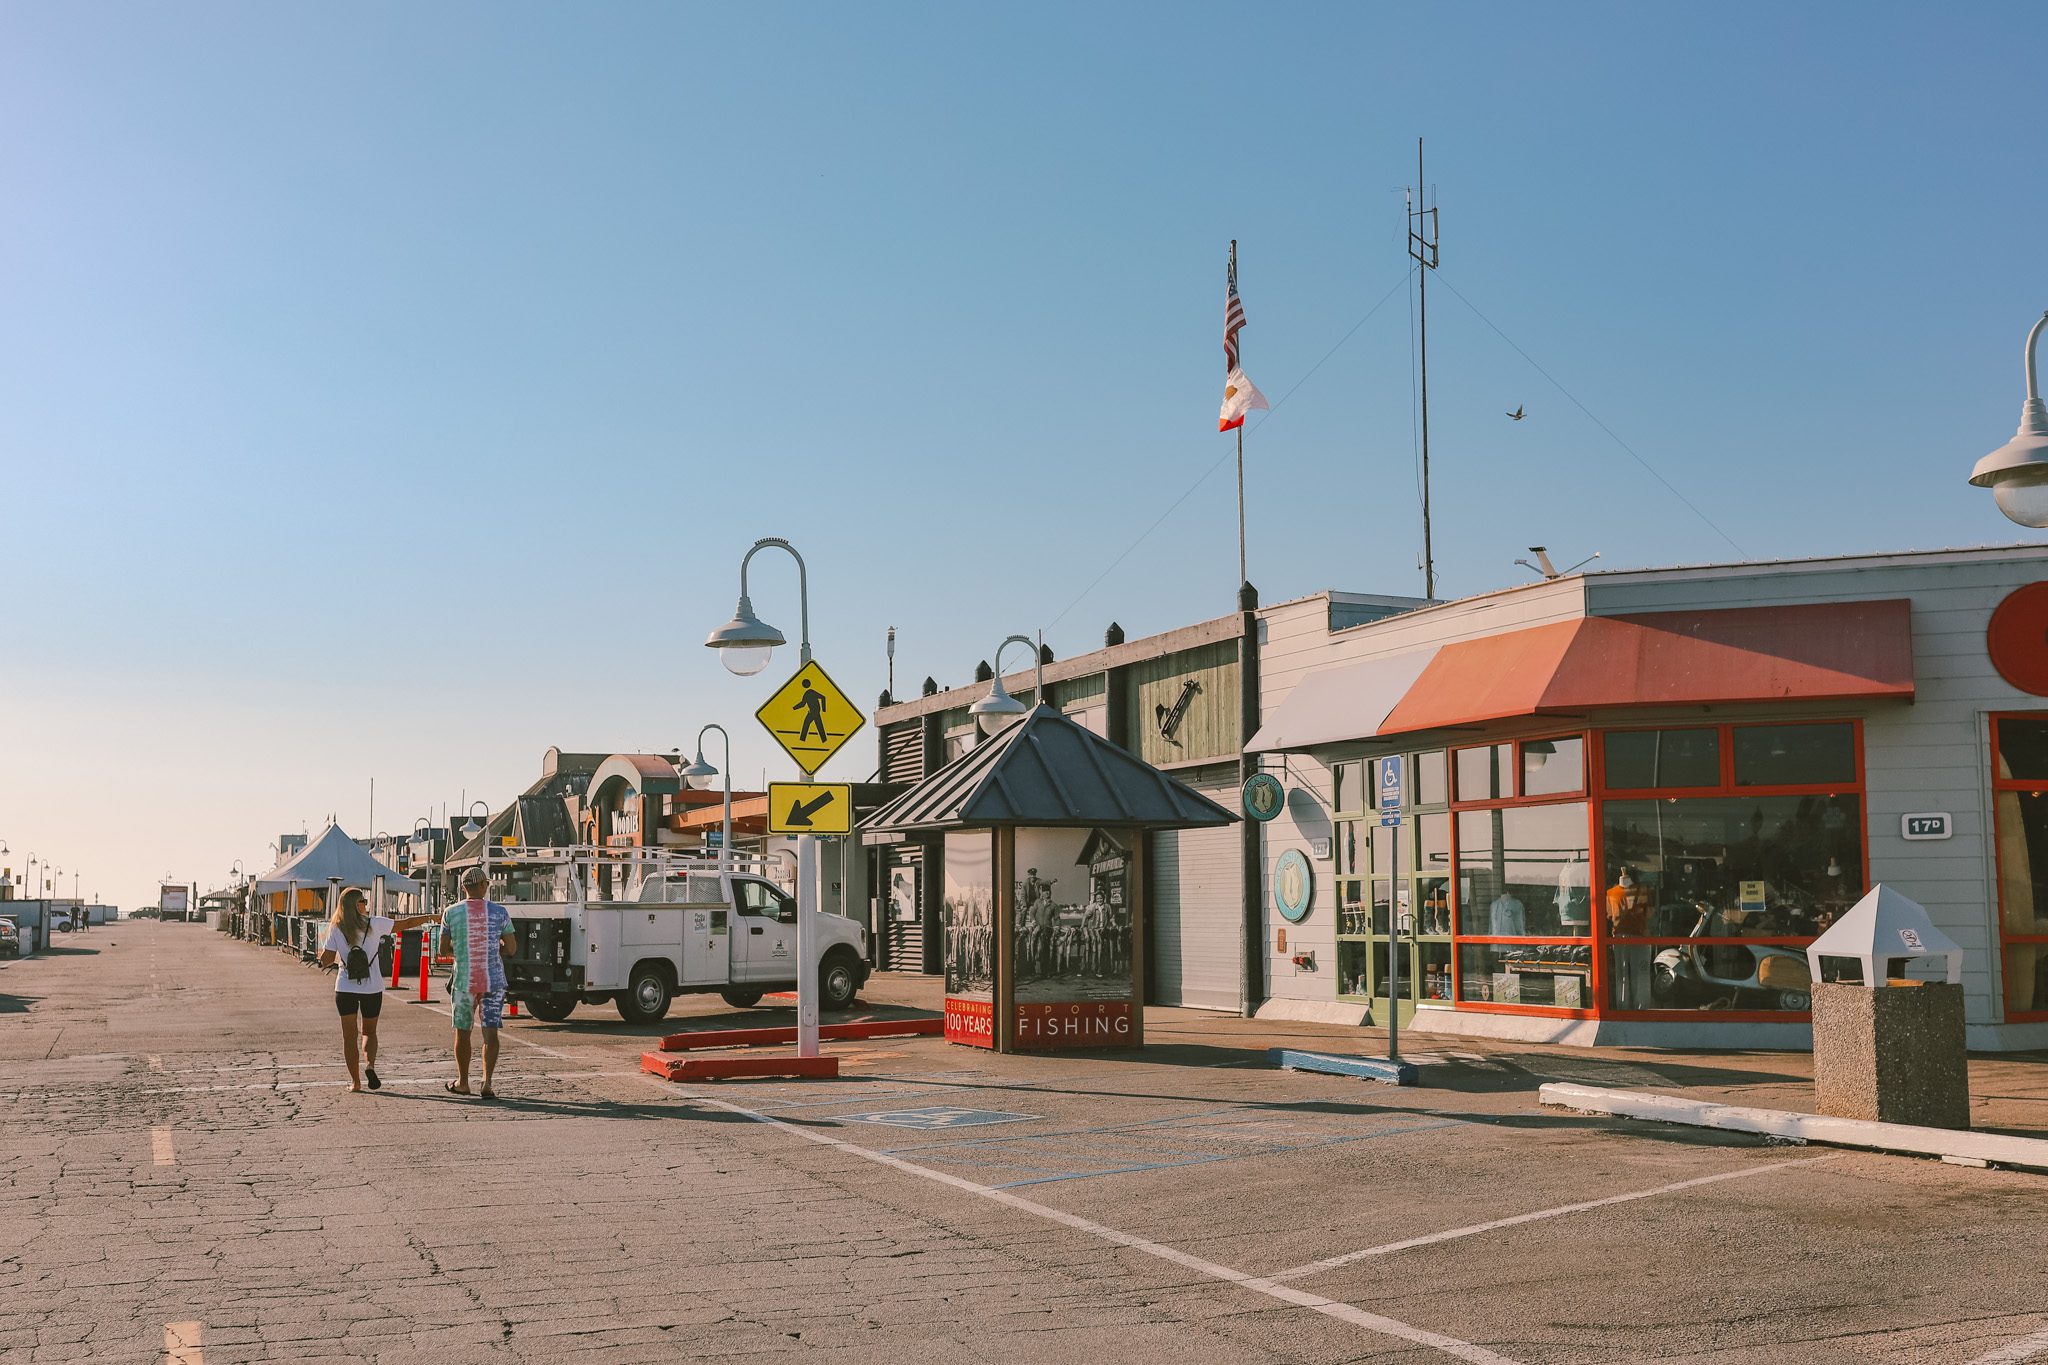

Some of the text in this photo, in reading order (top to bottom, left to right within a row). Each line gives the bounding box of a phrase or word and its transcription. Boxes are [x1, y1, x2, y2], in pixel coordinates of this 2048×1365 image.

[1911, 819, 1941, 832] 17D
[946, 1000, 992, 1015] CELEBRATING
[1019, 1003, 1129, 1016] SPORT
[946, 1012, 992, 1036] 100 YEARS
[1019, 1016, 1129, 1036] FISHING
